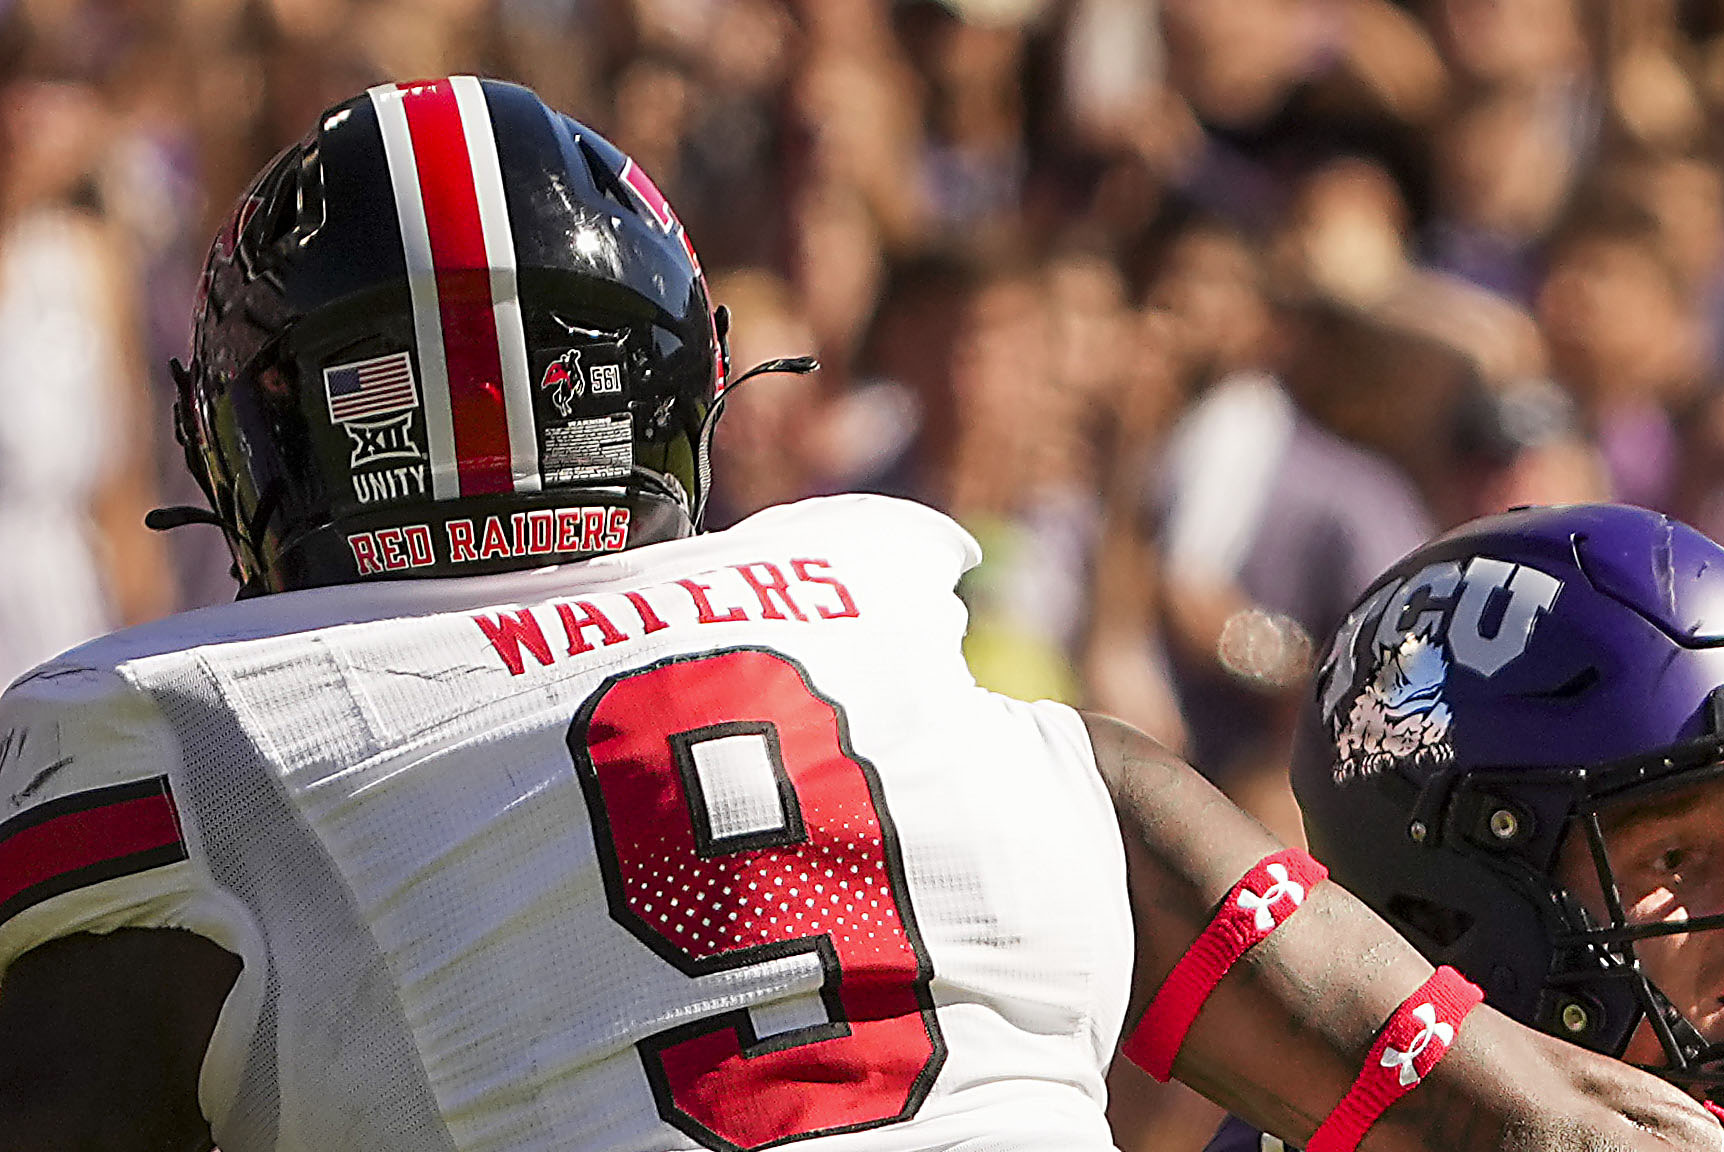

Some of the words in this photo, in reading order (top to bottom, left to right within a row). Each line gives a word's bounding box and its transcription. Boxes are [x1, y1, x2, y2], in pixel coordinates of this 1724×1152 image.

[590, 365, 621, 393] 561
[352, 465, 426, 503] UNITY
[347, 525, 436, 576] RED
[446, 506, 631, 562] RAIDERS
[472, 558, 861, 676] WATERS
